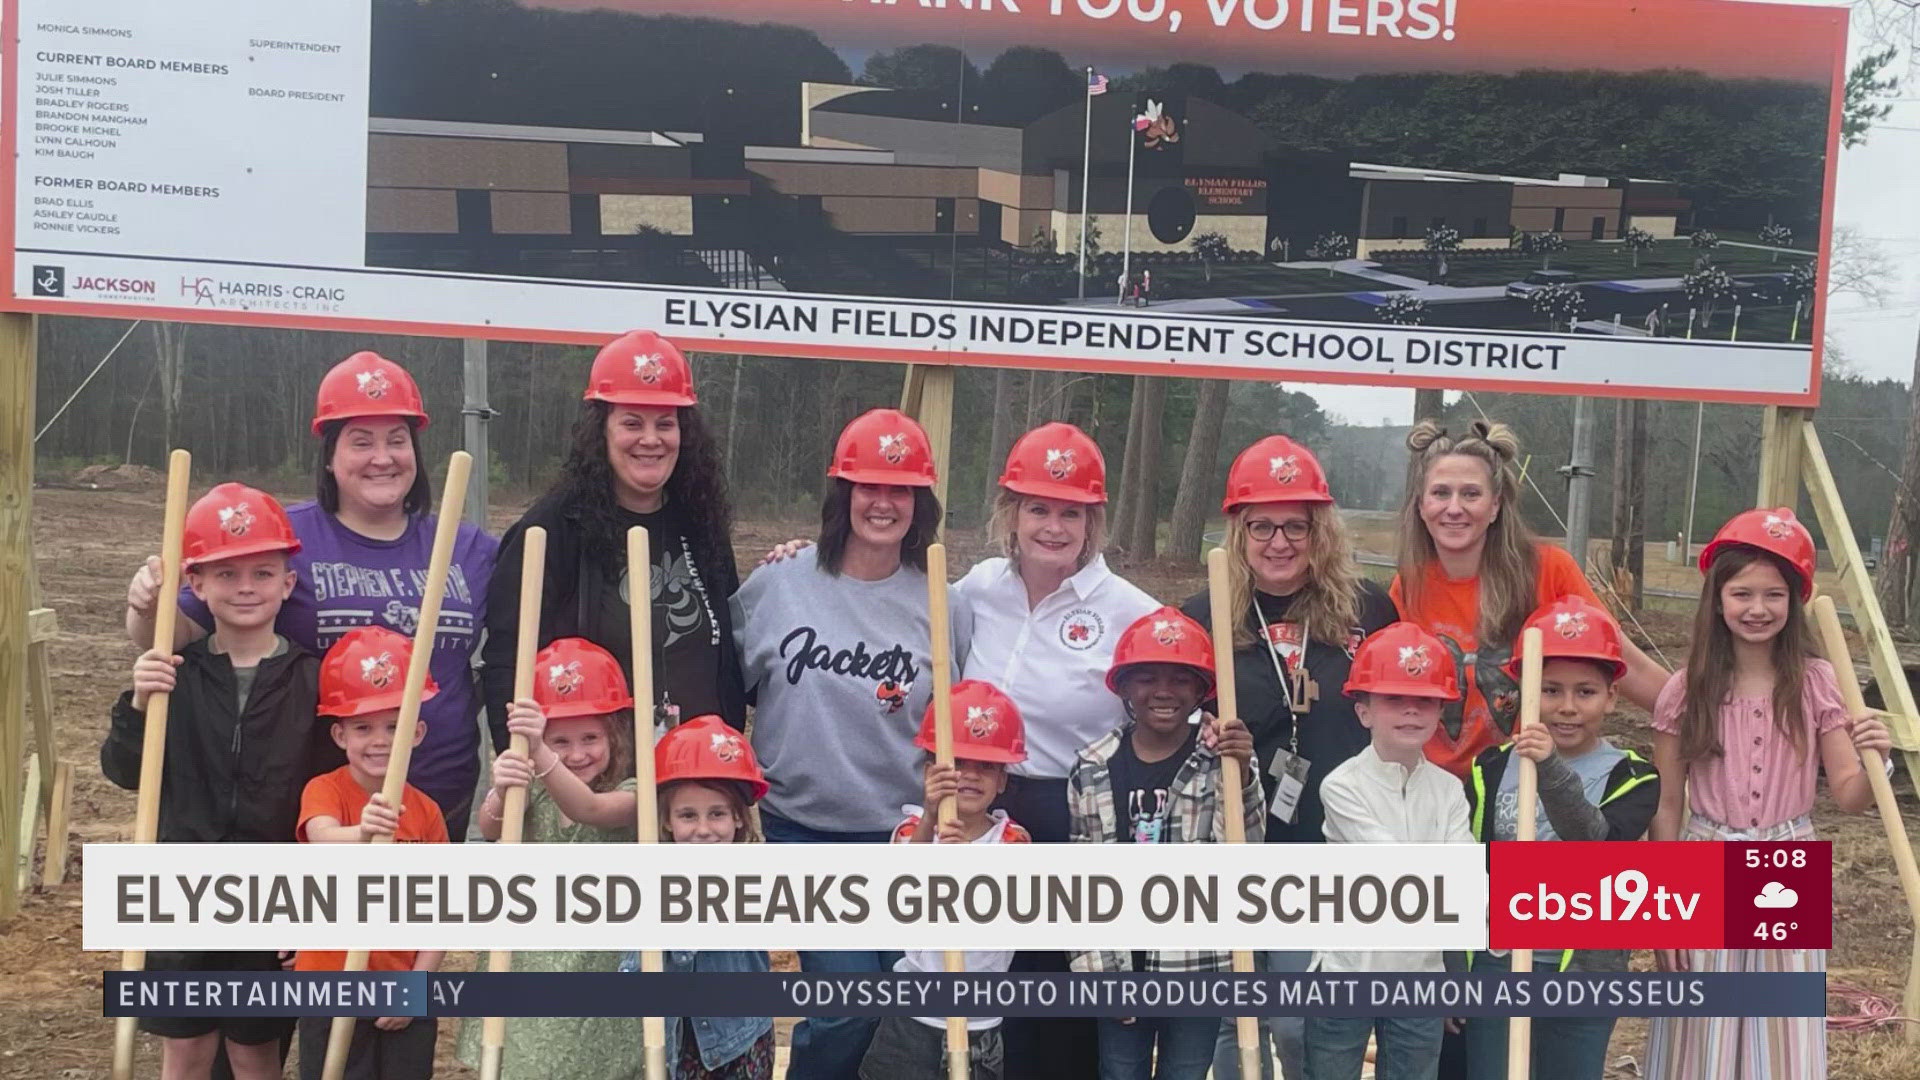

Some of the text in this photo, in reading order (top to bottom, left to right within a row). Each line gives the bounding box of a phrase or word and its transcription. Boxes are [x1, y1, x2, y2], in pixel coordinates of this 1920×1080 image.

[1210, 0, 1456, 41] VOTERS!
[37, 23, 133, 38] MONICA SIMMONS
[249, 39, 341, 53] SUPERINTENDENT
[36, 51, 229, 75] CURRENT BOARD MEMBERS
[36, 72, 117, 86] JULIE SIMMONS
[35, 85, 100, 97] JOSH TILLER
[248, 87, 345, 102] BOARD PRESIDENT
[36, 98, 129, 112] BRADLEY ROGERS
[36, 110, 148, 125] BRANDON MANGHAM
[35, 123, 121, 136] BROOKE MICHEL
[35, 136, 116, 148] LYNN CALHOUN
[35, 148, 95, 160] KIM BAUGH
[35, 176, 220, 198] FORMER BOARD MEMBERS
[34, 196, 94, 208] BRAD ELLIS
[33, 209, 118, 223] ASHLEY CAUDLE
[34, 222, 120, 235] RONNIE VICKERS
[72, 276, 155, 294] JACKSON
[219, 282, 345, 301] HARRIS CRAIG
[664, 299, 1566, 370] ELYSIAN FIELDS INDEPENDENT SCHOOL DISTRICT
[312, 562, 394, 601] STEPHEN
[780, 626, 919, 685] Jackets
